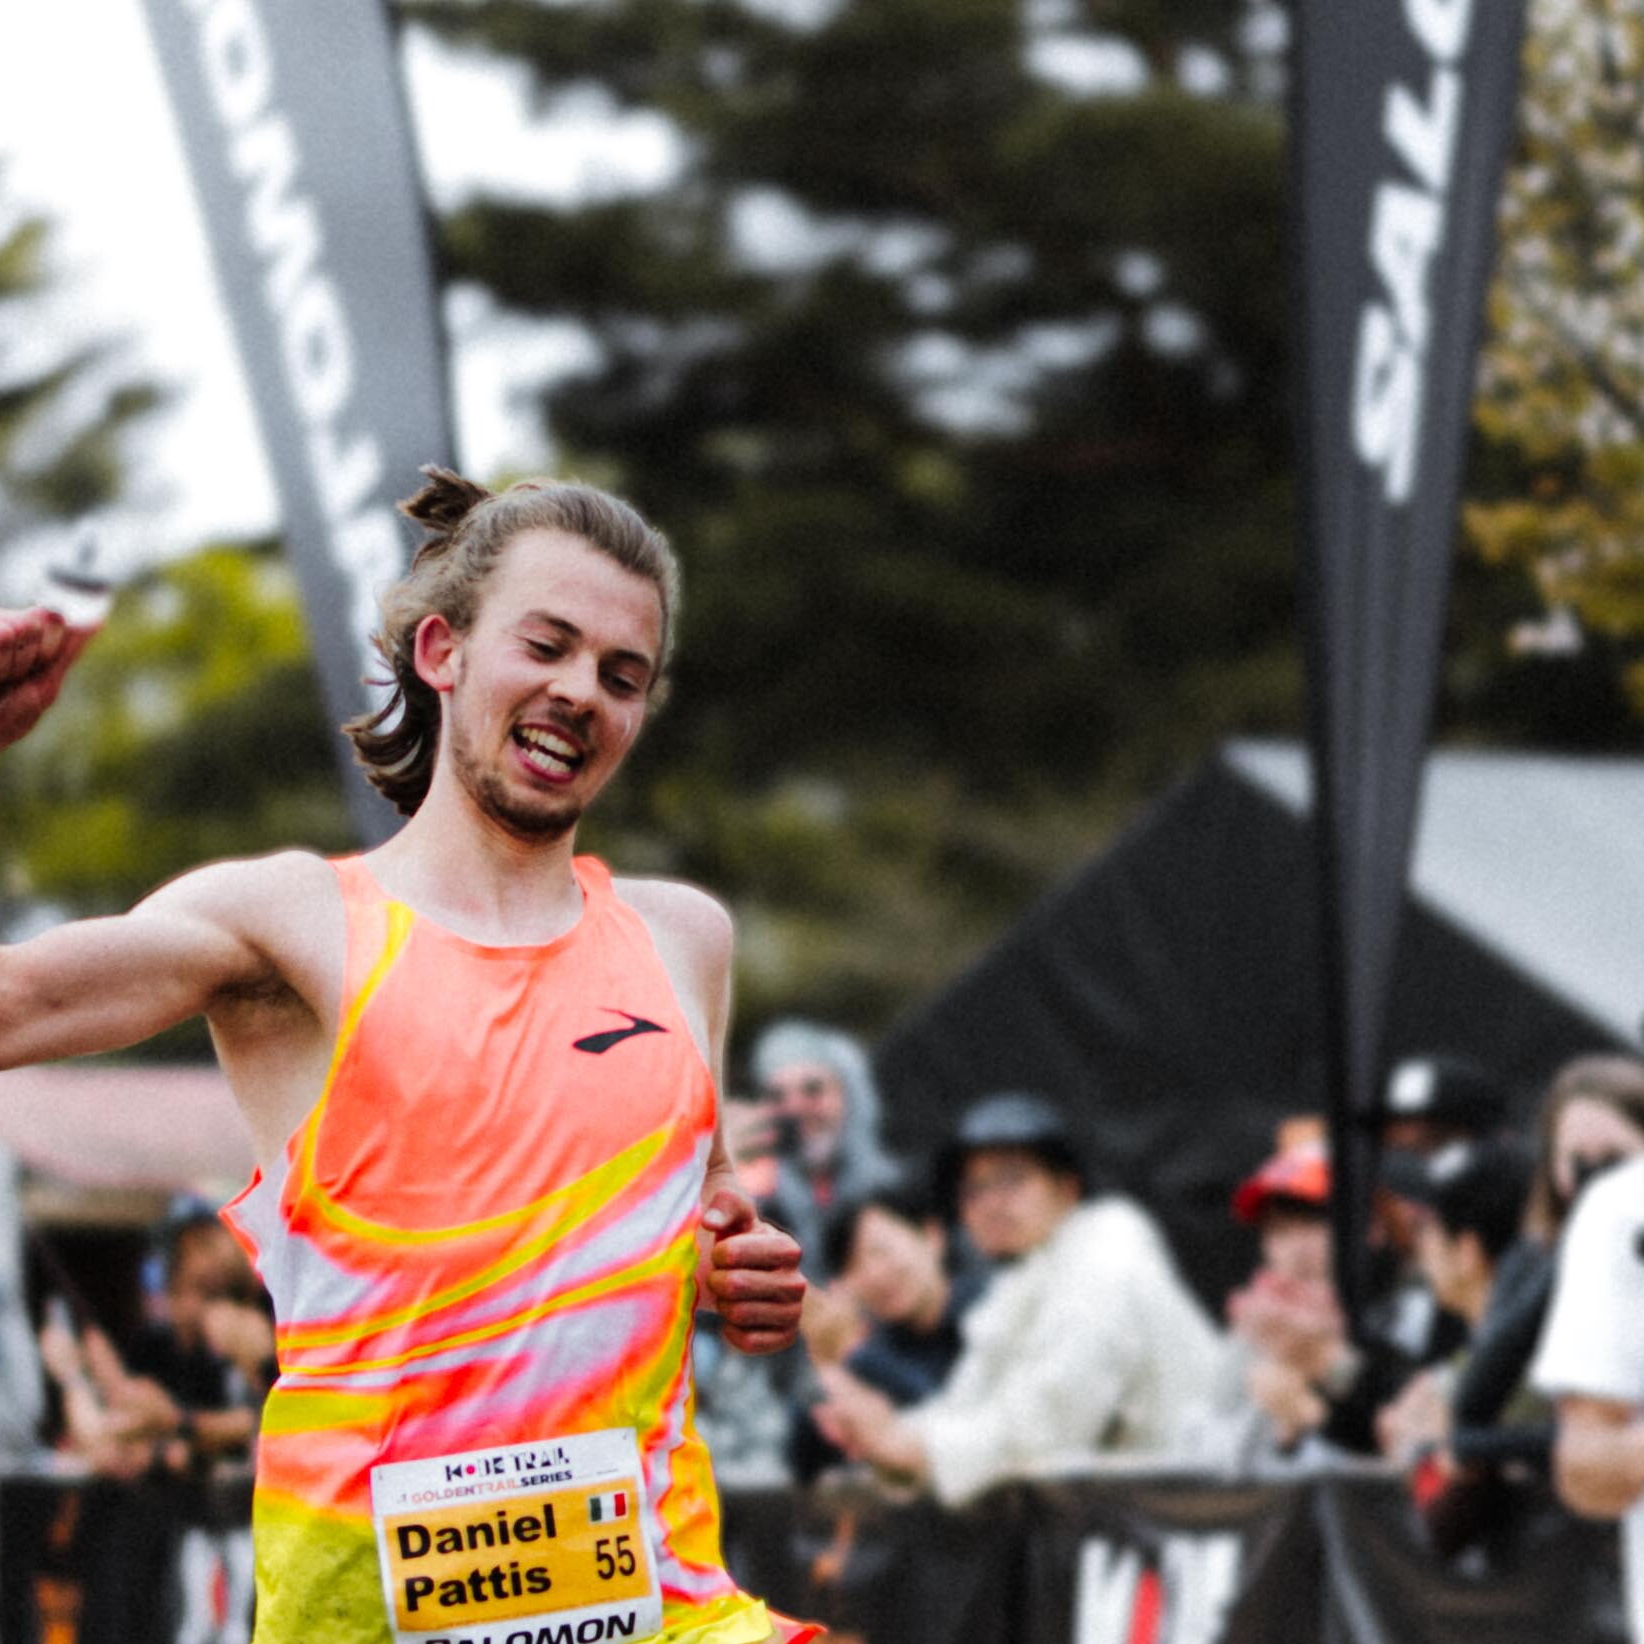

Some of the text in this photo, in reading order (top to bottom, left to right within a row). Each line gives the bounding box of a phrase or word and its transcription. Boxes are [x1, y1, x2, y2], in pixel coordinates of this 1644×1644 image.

[397, 1503, 557, 1560] Daniel
[595, 1535, 636, 1580] 55
[405, 1562, 553, 1612] Pattis
